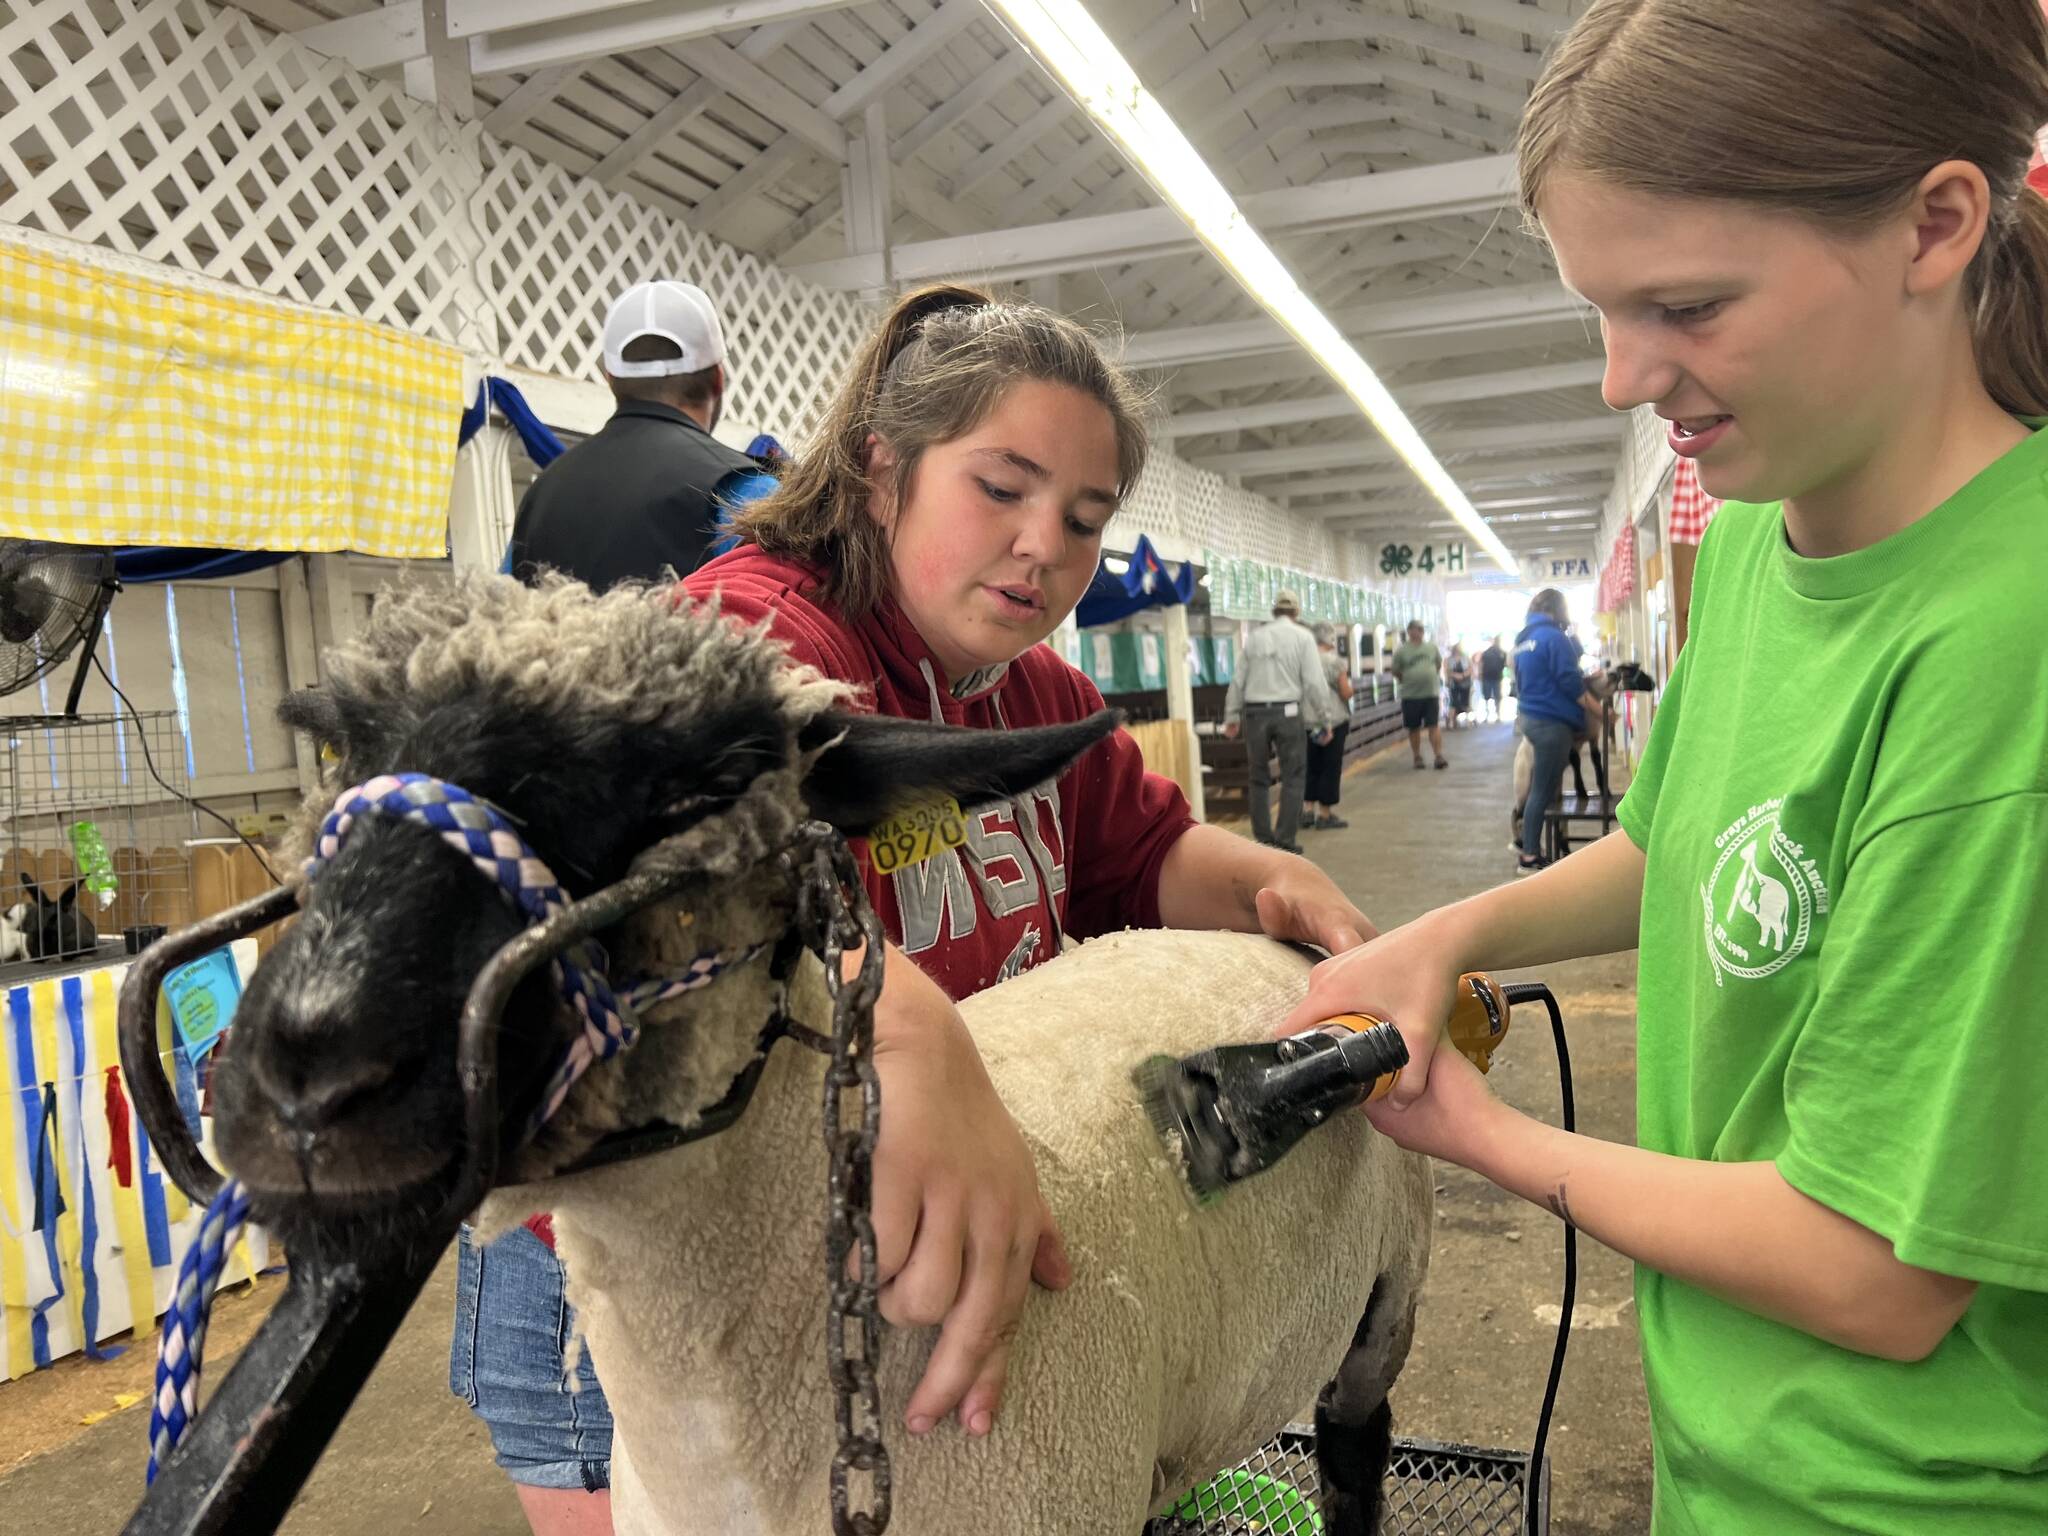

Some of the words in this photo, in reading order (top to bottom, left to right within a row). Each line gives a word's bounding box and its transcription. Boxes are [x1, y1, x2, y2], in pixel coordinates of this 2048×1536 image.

[1417, 543, 1464, 573] 4-H
[1551, 558, 1590, 577] FFA
[1747, 797, 1783, 821] Harb
[875, 817, 964, 870] 0970
[892, 778, 1066, 955] WSU
